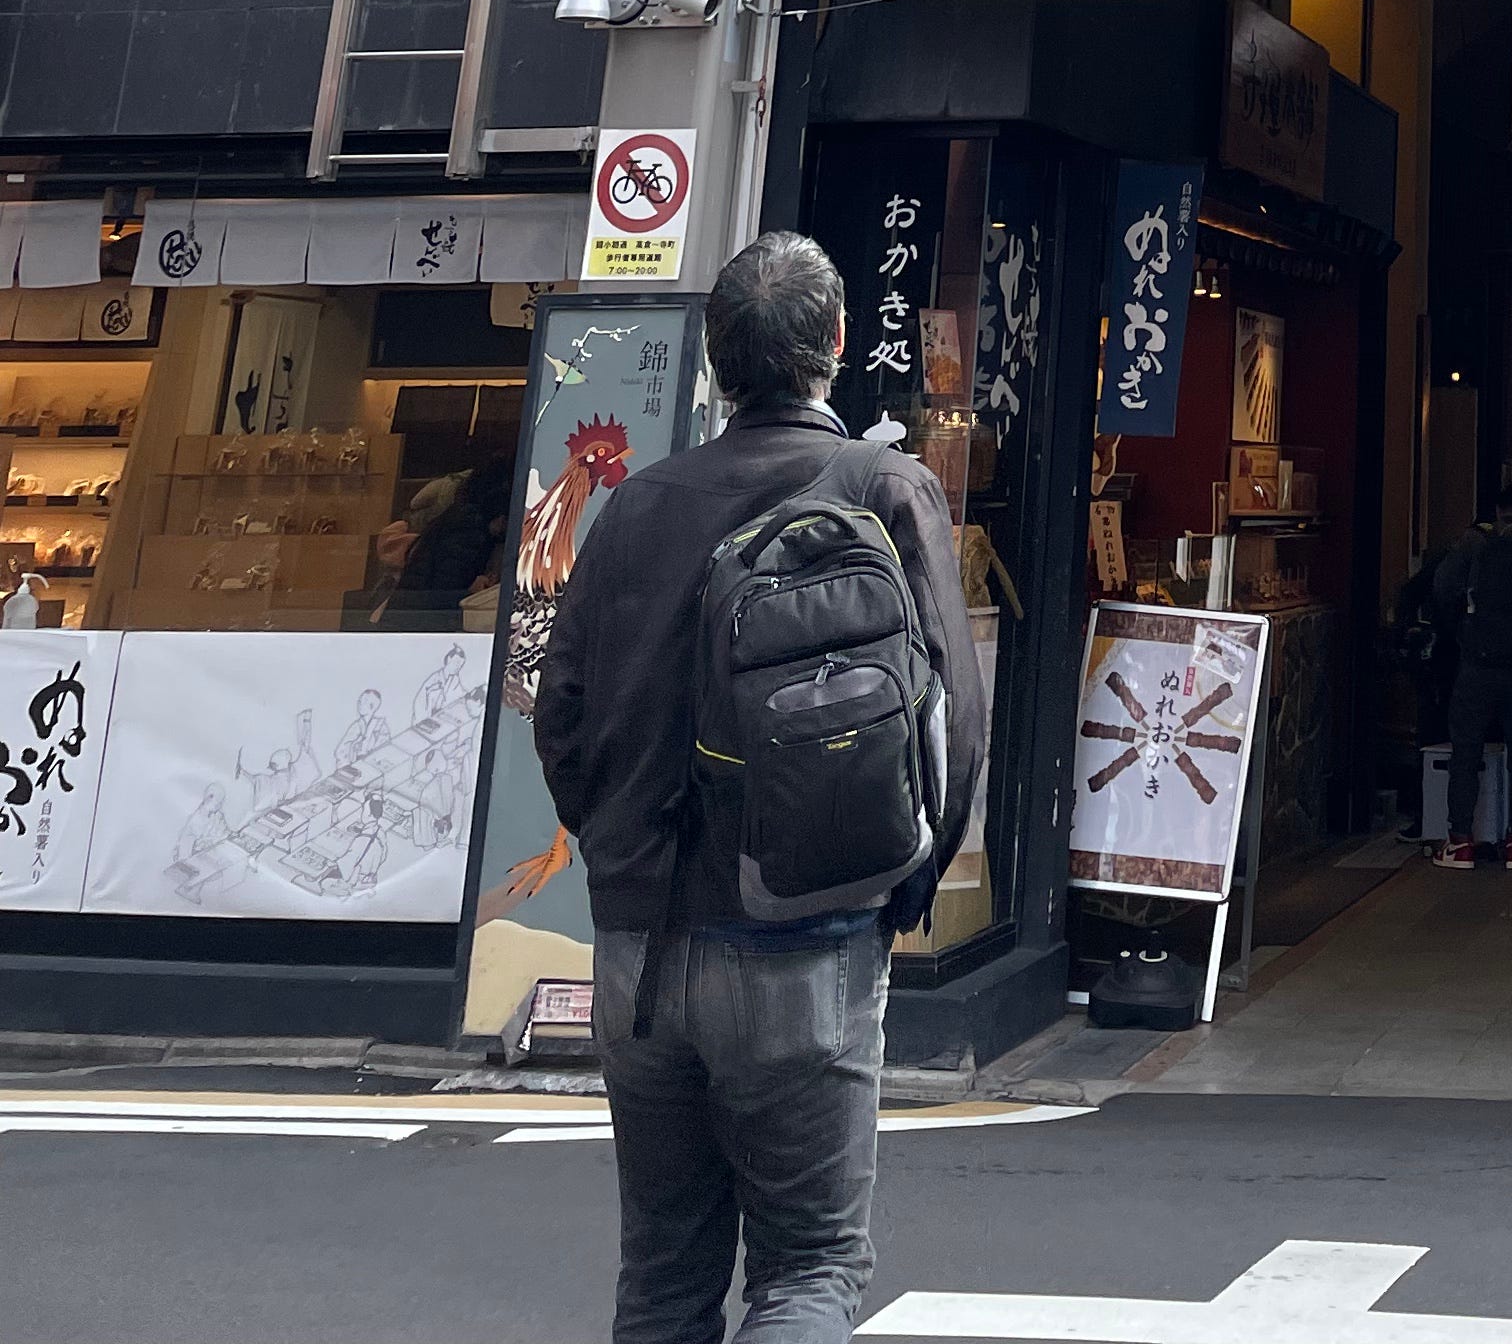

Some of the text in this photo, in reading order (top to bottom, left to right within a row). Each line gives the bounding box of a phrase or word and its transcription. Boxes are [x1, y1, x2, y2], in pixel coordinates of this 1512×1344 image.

[865, 193, 921, 374] おかき処
[1117, 204, 1171, 410] ぬれおかき
[638, 340, 668, 418] 錦市場
[1143, 670, 1180, 800] ぬれおかき
